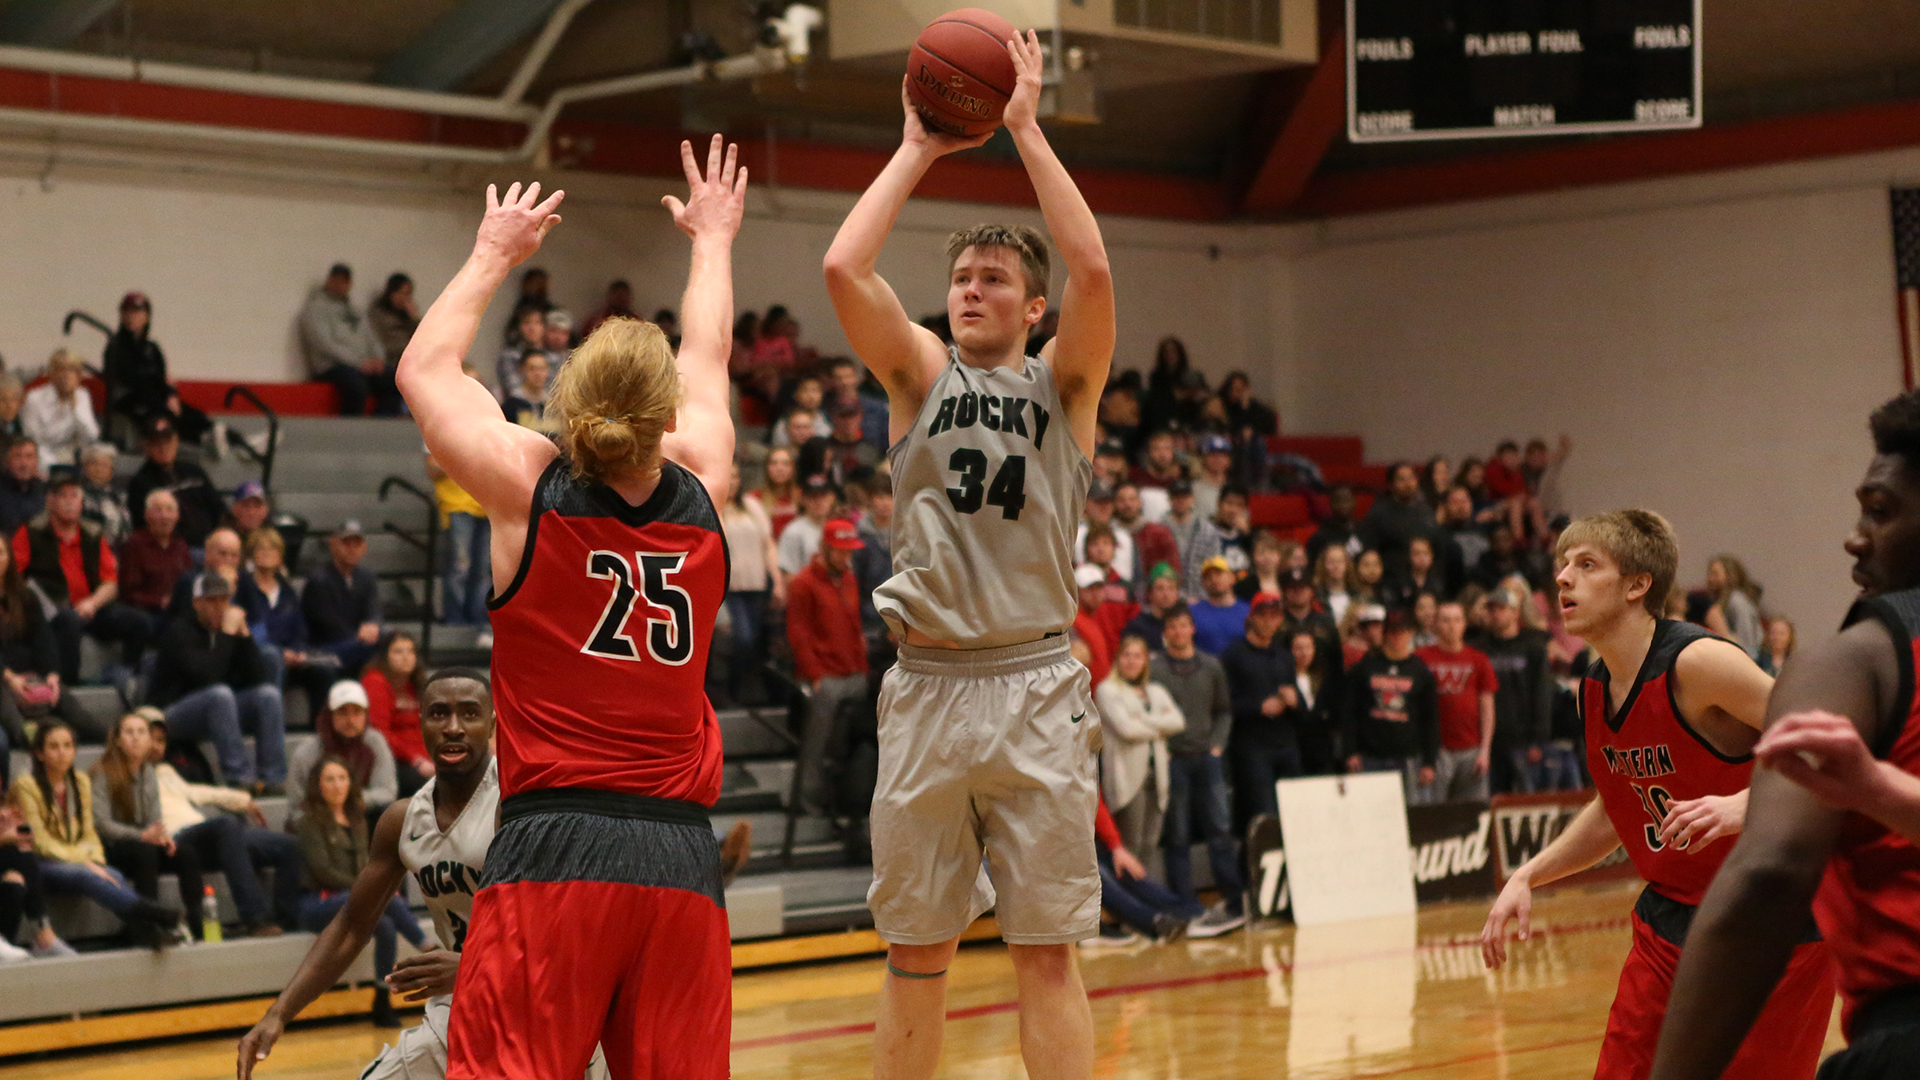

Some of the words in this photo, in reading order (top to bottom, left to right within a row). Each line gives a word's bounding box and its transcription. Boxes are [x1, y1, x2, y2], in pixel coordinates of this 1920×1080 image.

[1357, 38, 1414, 60] FOULS
[1465, 32, 1531, 55] PLAYER
[1539, 29, 1584, 52] FOUL
[1634, 25, 1691, 48] FOULS
[916, 64, 994, 117] SPALDING
[1358, 111, 1413, 133] SCORE
[1494, 105, 1556, 126] MATCH
[1634, 99, 1690, 121] SCORE
[928, 391, 1050, 451] ROCKY
[946, 448, 1026, 521] 34
[580, 550, 694, 666] 25
[1601, 745, 1676, 778] WTERN
[1410, 810, 1491, 883] und
[414, 861, 482, 897] OCK
